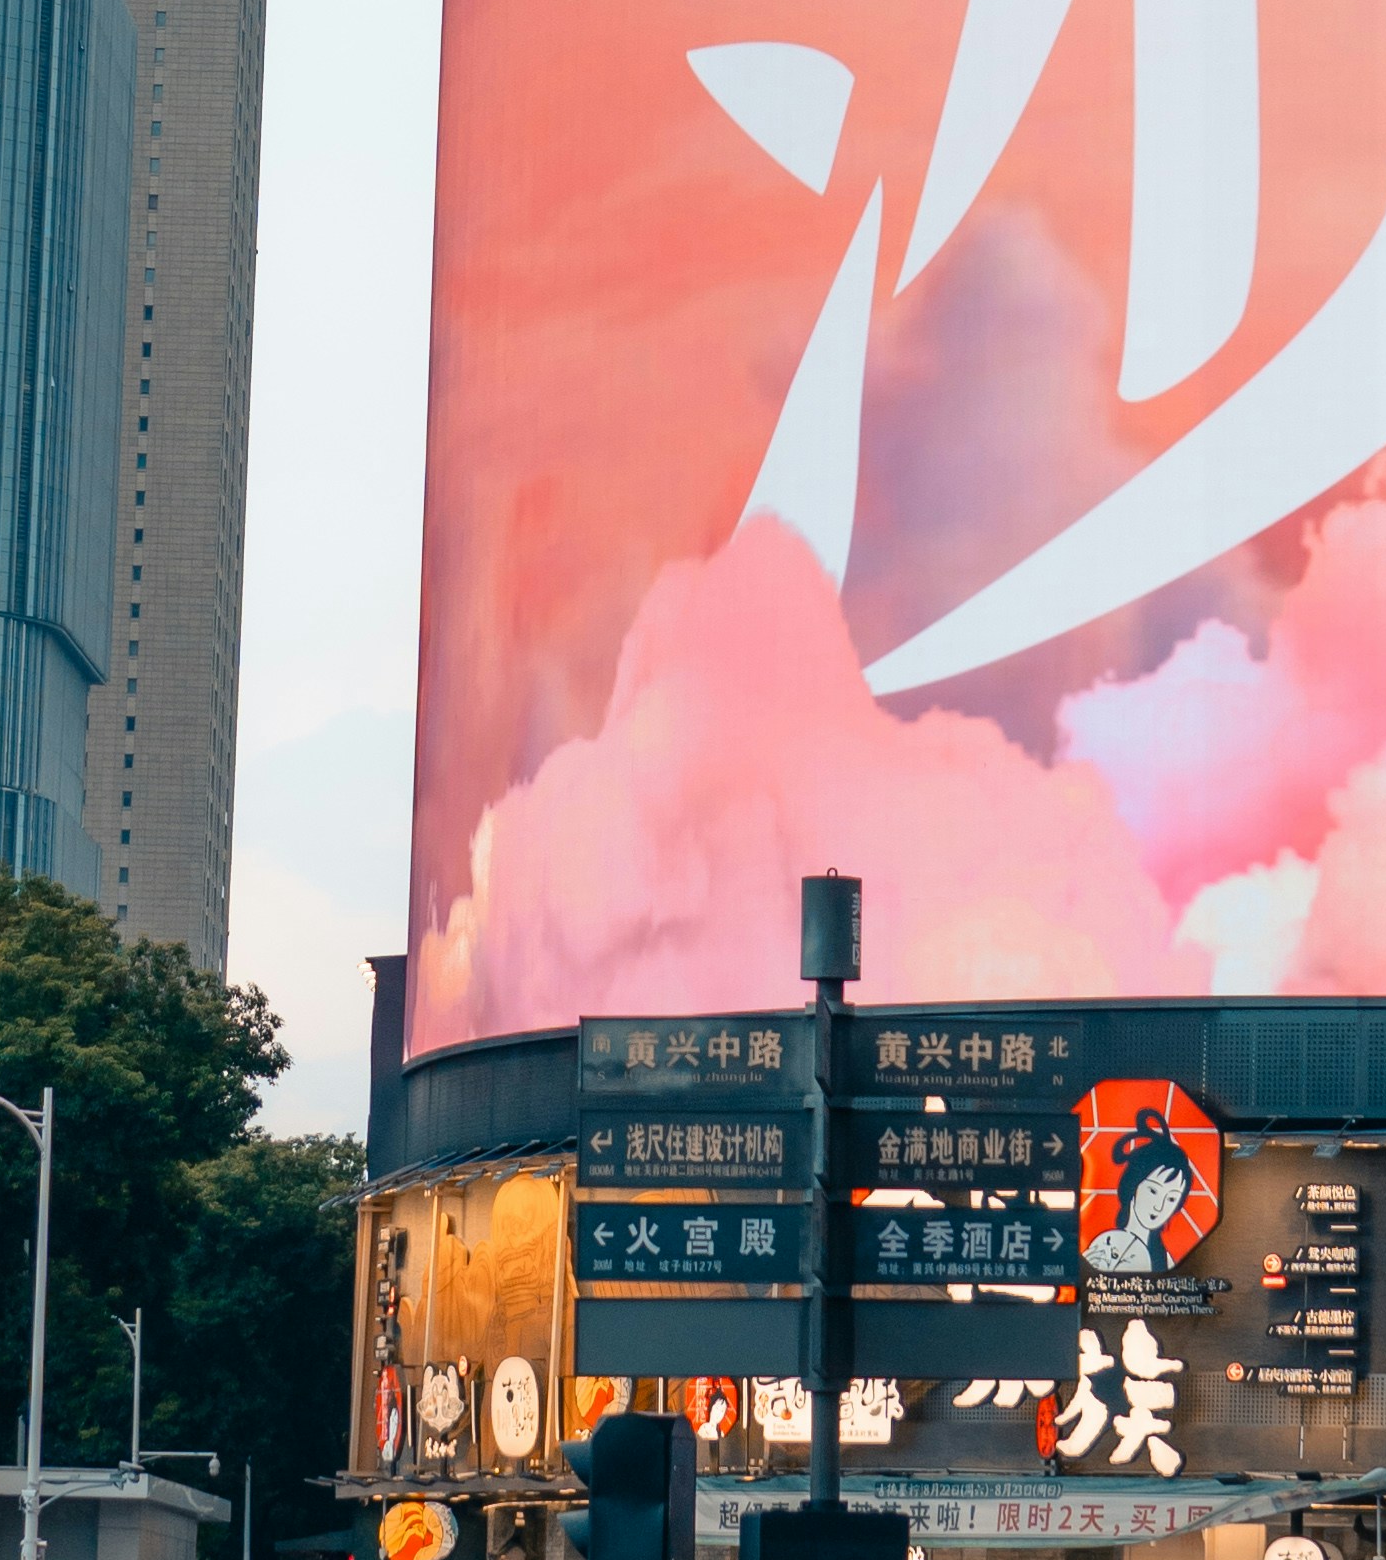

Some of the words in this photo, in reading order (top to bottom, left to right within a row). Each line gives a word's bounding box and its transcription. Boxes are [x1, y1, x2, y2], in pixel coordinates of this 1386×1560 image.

[593, 1033, 611, 1054] 南
[625, 1029, 783, 1070] 黄兴中路
[875, 1031, 1036, 1073] 黄兴中路
[1048, 1035, 1069, 1058] 北
[875, 1072, 919, 1086] Huang
[923, 1073, 953, 1086] xing
[956, 1073, 999, 1087] zhong
[1002, 1072, 1015, 1085] lu
[1053, 1075, 1063, 1085] N
[625, 1123, 783, 1163] 浅尺住建设计机构
[878, 1126, 1033, 1167] 金满地商业街
[625, 1215, 777, 1257] 火宫殿
[877, 1218, 1032, 1261] 全季酒店
[1088, 1292, 1101, 1306] Big
[1141, 1292, 1162, 1304] Small
[1162, 1293, 1203, 1306] Courtyard
[1088, 1304, 1100, 1314] An
[1100, 1304, 1143, 1317] Interesting
[1144, 1304, 1169, 1317] Family
